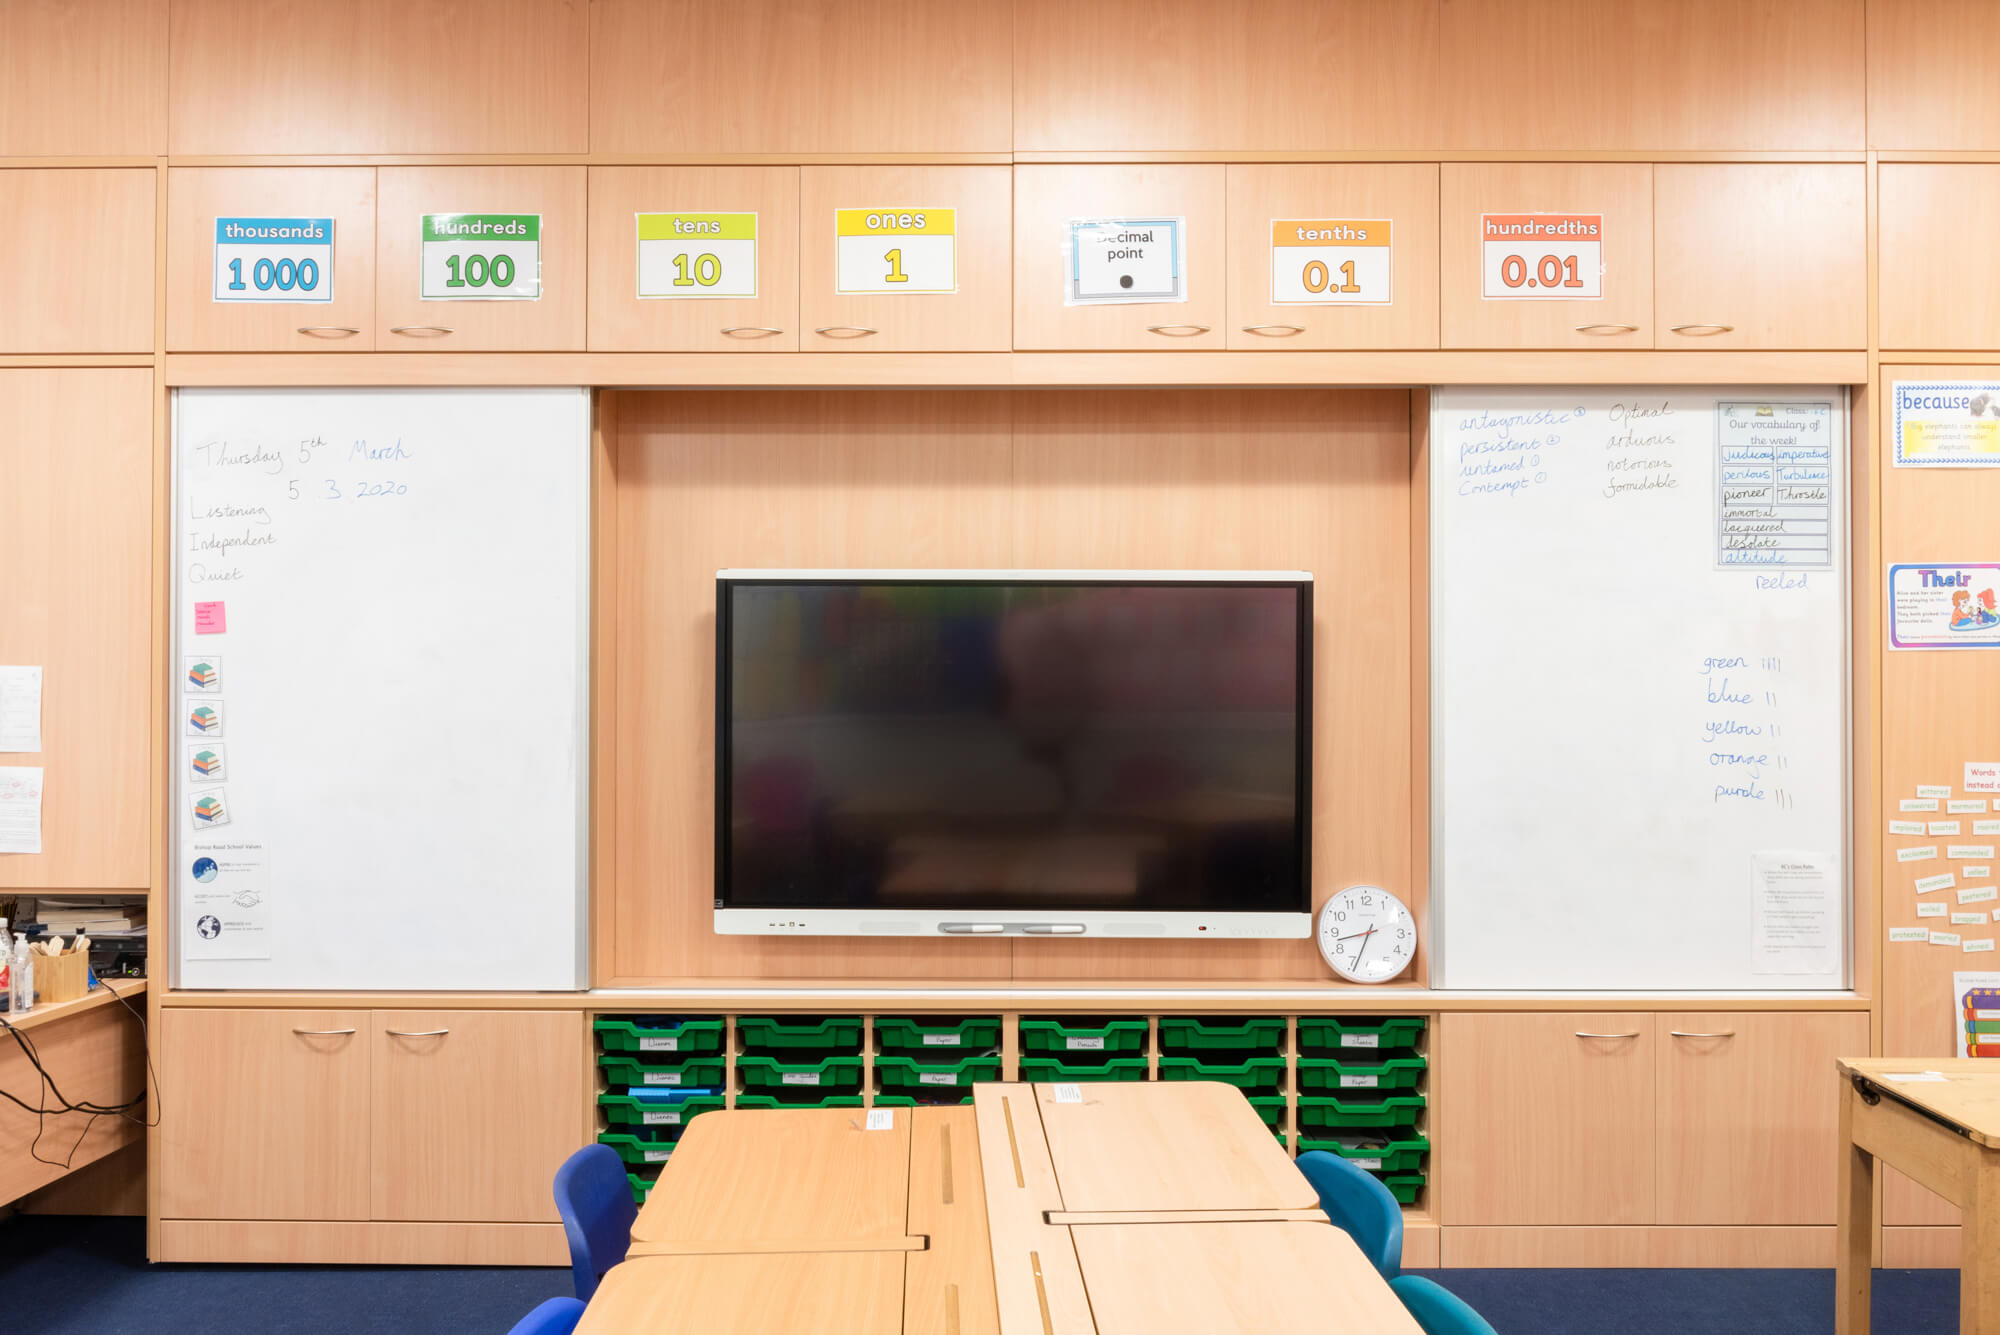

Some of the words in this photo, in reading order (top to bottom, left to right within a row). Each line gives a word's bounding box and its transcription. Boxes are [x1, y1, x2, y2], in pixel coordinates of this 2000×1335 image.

[433, 219, 527, 237] hundreds
[674, 217, 721, 235] tens
[865, 211, 927, 230] ones
[1486, 219, 1598, 236] hundredths
[225, 221, 324, 240] thousands
[1296, 225, 1368, 241] tenths
[1107, 245, 1144, 262] point
[446, 253, 516, 288] 100
[672, 252, 722, 287] 10
[883, 248, 909, 283] 1
[1501, 254, 1584, 289] 0.01
[1302, 259, 1361, 294] 0.1
[1903, 390, 1970, 409] because
[1729, 419, 1749, 430] Our
[1751, 419, 1807, 432] vocabulary
[1808, 419, 1821, 432] of
[1750, 436, 1768, 446] the
[1769, 436, 1798, 446] week!
[196, 439, 284, 475] Thursday
[349, 437, 411, 462] March
[288, 479, 300, 500] 5
[325, 478, 342, 500] 3
[356, 480, 408, 499] 2020
[1723, 487, 1771, 507] pioneer
[189, 528, 277, 557] Independent
[188, 563, 244, 584] Quiet
[1755, 572, 1808, 590] reeled
[1917, 569, 1972, 588] Their
[1698, 656, 1749, 675] green
[1707, 677, 1754, 705] blue
[1702, 719, 1762, 743] yellow
[1709, 752, 1769, 779] orange
[1970, 768, 1996, 777] Words
[1966, 780, 1995, 789] instead
[1345, 899, 1354, 910] 11
[1360, 895, 1373, 906] 12
[1333, 911, 1346, 922] 10
[1330, 927, 1340, 938] 9
[1396, 928, 1406, 939] 3
[1335, 943, 1345, 954] 8
[1393, 944, 1402, 954] 4
[1348, 955, 1357, 967] 7
